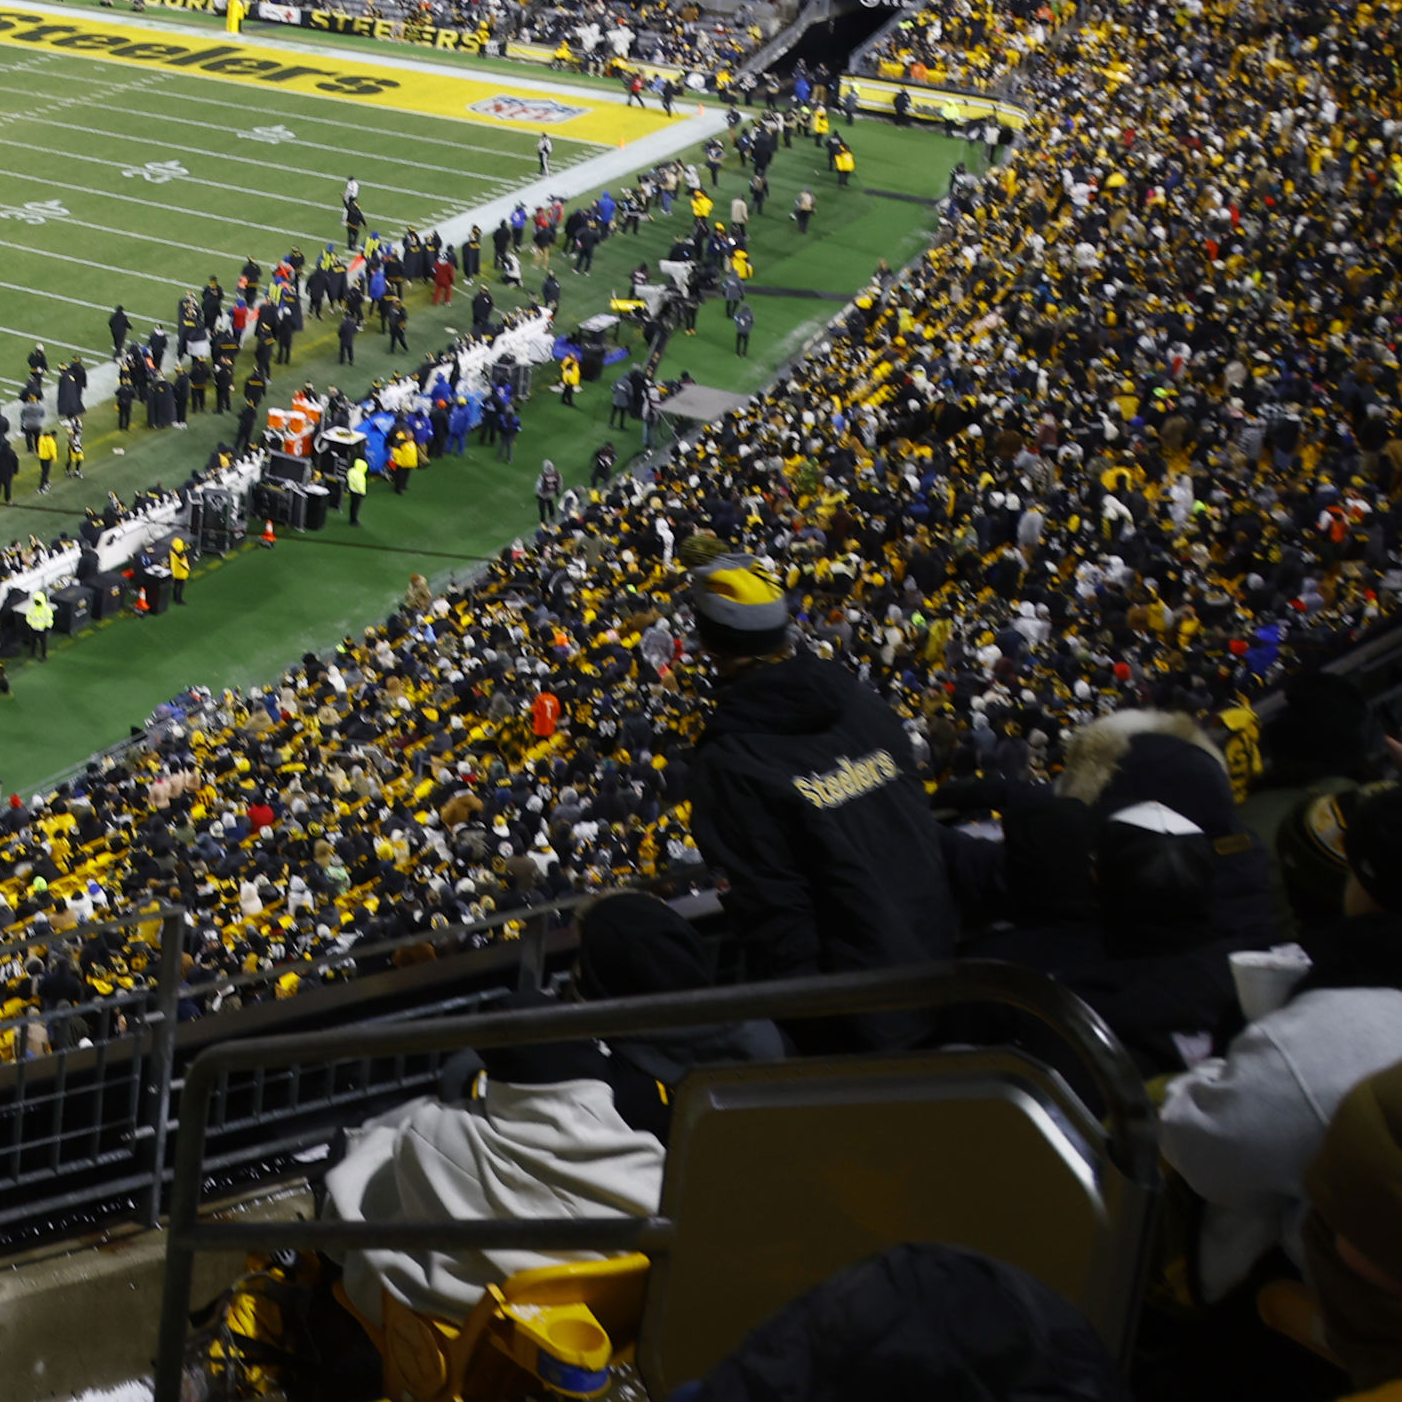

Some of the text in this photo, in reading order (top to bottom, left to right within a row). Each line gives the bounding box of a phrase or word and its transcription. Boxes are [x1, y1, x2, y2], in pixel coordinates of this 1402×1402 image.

[311, 9, 484, 54] STEEERS
[121, 161, 190, 184] 20
[791, 747, 899, 811] Steelers
